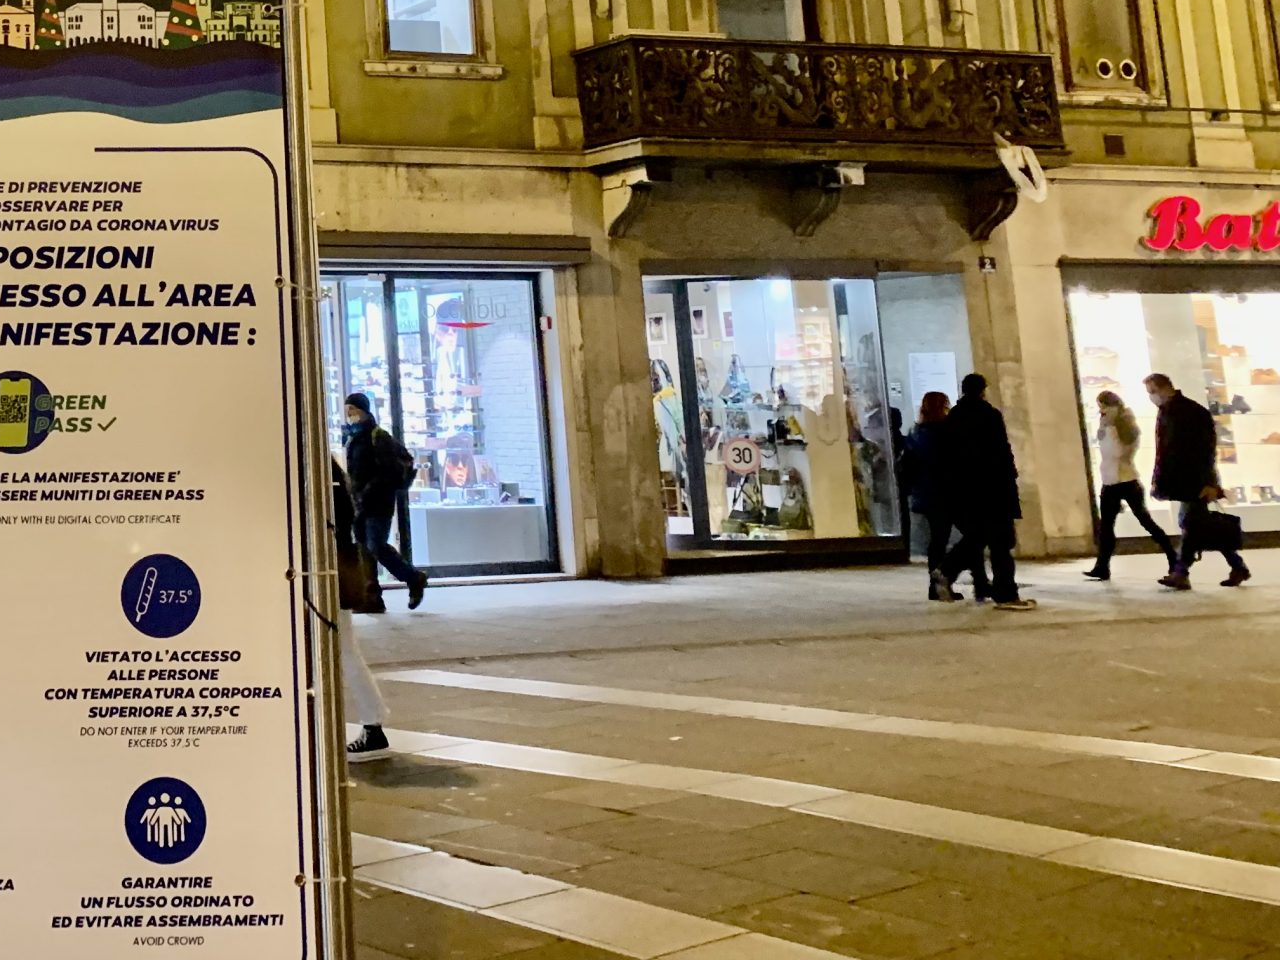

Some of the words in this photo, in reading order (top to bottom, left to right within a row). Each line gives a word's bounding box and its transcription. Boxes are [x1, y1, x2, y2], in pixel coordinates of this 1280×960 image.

[8, 182, 24, 193] DI
[27, 181, 142, 193] PREVENZIONE
[92, 200, 123, 212] PER
[70, 219, 92, 231] DA
[97, 219, 219, 231] CORONAVIRUS
[984, 258, 991, 269] 2
[92, 281, 256, 307] ALL'AREA
[35, 395, 107, 411] GREEN
[34, 417, 92, 433] PASS
[732, 447, 752, 464] 30
[12, 472, 30, 483] LA
[34, 472, 165, 483] MANIFESTAZIONE
[167, 471, 180, 482] E'
[40, 490, 93, 501] MUNITI
[96, 490, 110, 501] DI
[113, 489, 162, 500] GREEN
[165, 489, 204, 500] PASS
[21, 515, 42, 524] WITH
[45, 516, 55, 524] EU
[58, 515, 91, 524] DIGITAL
[95, 515, 125, 524] COVID
[128, 515, 180, 524] CERTIFICATE
[86, 651, 152, 663] VIETATO
[155, 649, 241, 662] L'ACCESSO
[107, 669, 146, 681] ALLE
[148, 669, 219, 680] PERSONE
[45, 688, 78, 700] CON
[81, 687, 195, 699] TEMPERATURA
[199, 687, 282, 699] CORPOREA
[88, 706, 174, 718] SUPERIORE
[176, 706, 187, 717] A
[191, 706, 240, 719] 37,5°C
[80, 727, 95, 736] DO
[98, 727, 118, 736] NOT
[121, 727, 147, 735] ENTER
[150, 726, 157, 735] IF
[161, 726, 184, 735] YOUR
[188, 726, 247, 735] TEMPERATURE
[128, 738, 167, 747] EXCEEDS
[122, 877, 213, 889] GARANTIRE
[81, 897, 104, 909] UN
[106, 896, 167, 908] FLUSSO
[171, 895, 254, 908] ORDINATO
[52, 916, 72, 928] ED
[75, 915, 143, 928] EVITARE
[146, 914, 284, 927] ASSEMBRAMENTI
[133, 937, 164, 946] AVOID
[167, 936, 204, 945] CROWD
